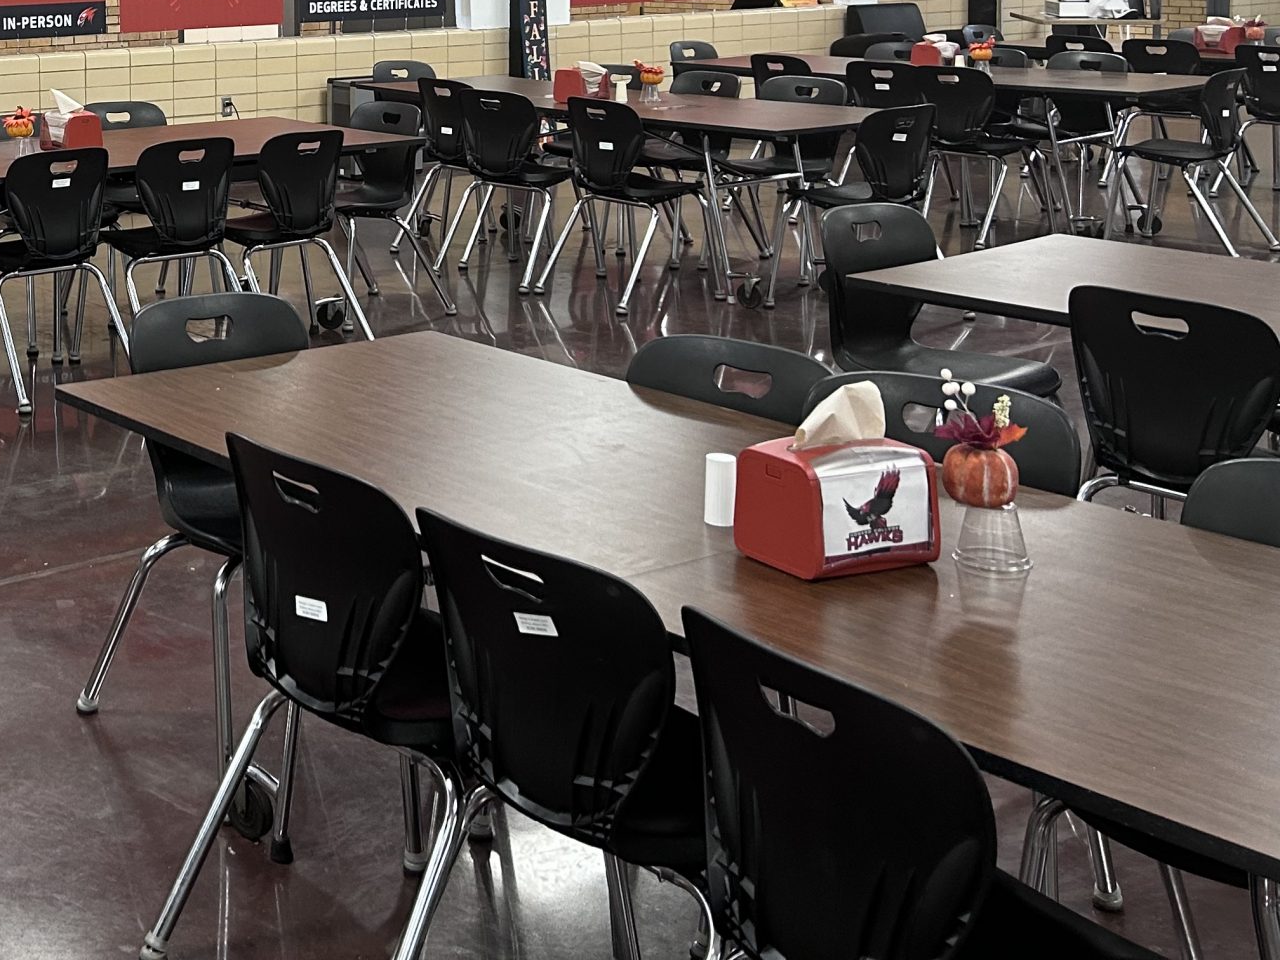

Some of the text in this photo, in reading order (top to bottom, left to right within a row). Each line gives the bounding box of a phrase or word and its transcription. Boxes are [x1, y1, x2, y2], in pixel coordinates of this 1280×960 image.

[309, 0, 357, 14] DEGREES
[2, 14, 73, 30] IN-PERSON
[846, 530, 903, 551] HAWKS
